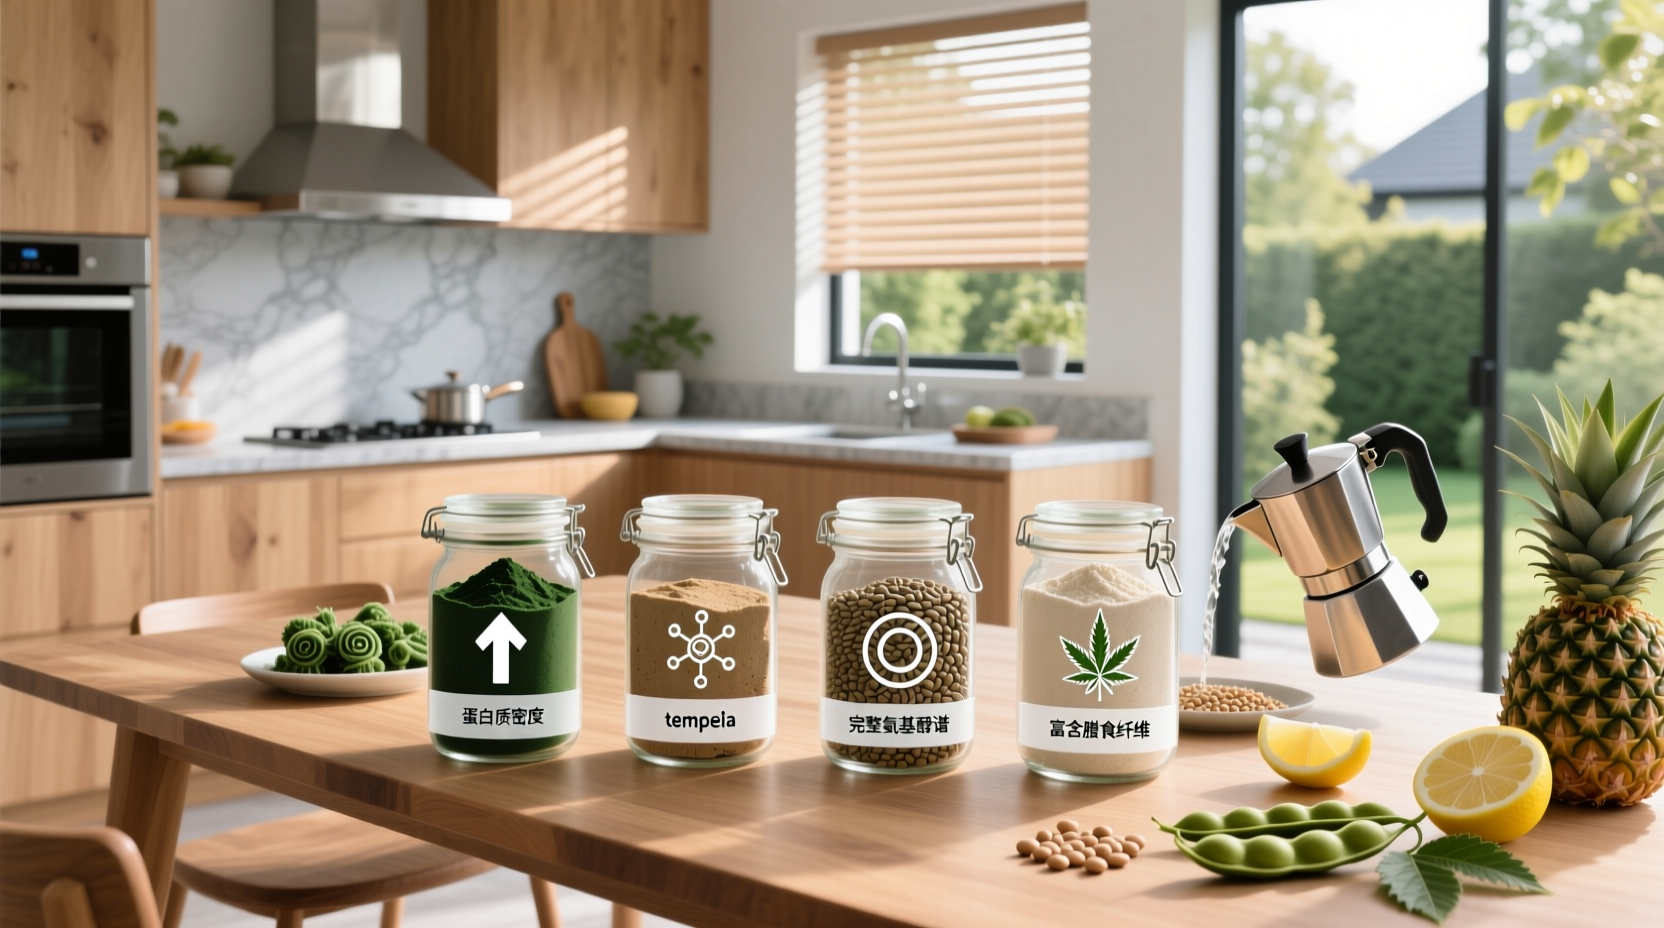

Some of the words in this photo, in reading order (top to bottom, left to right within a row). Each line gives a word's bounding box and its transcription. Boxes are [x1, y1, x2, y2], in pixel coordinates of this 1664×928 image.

[462, 707, 545, 727] 蛋白质密度
